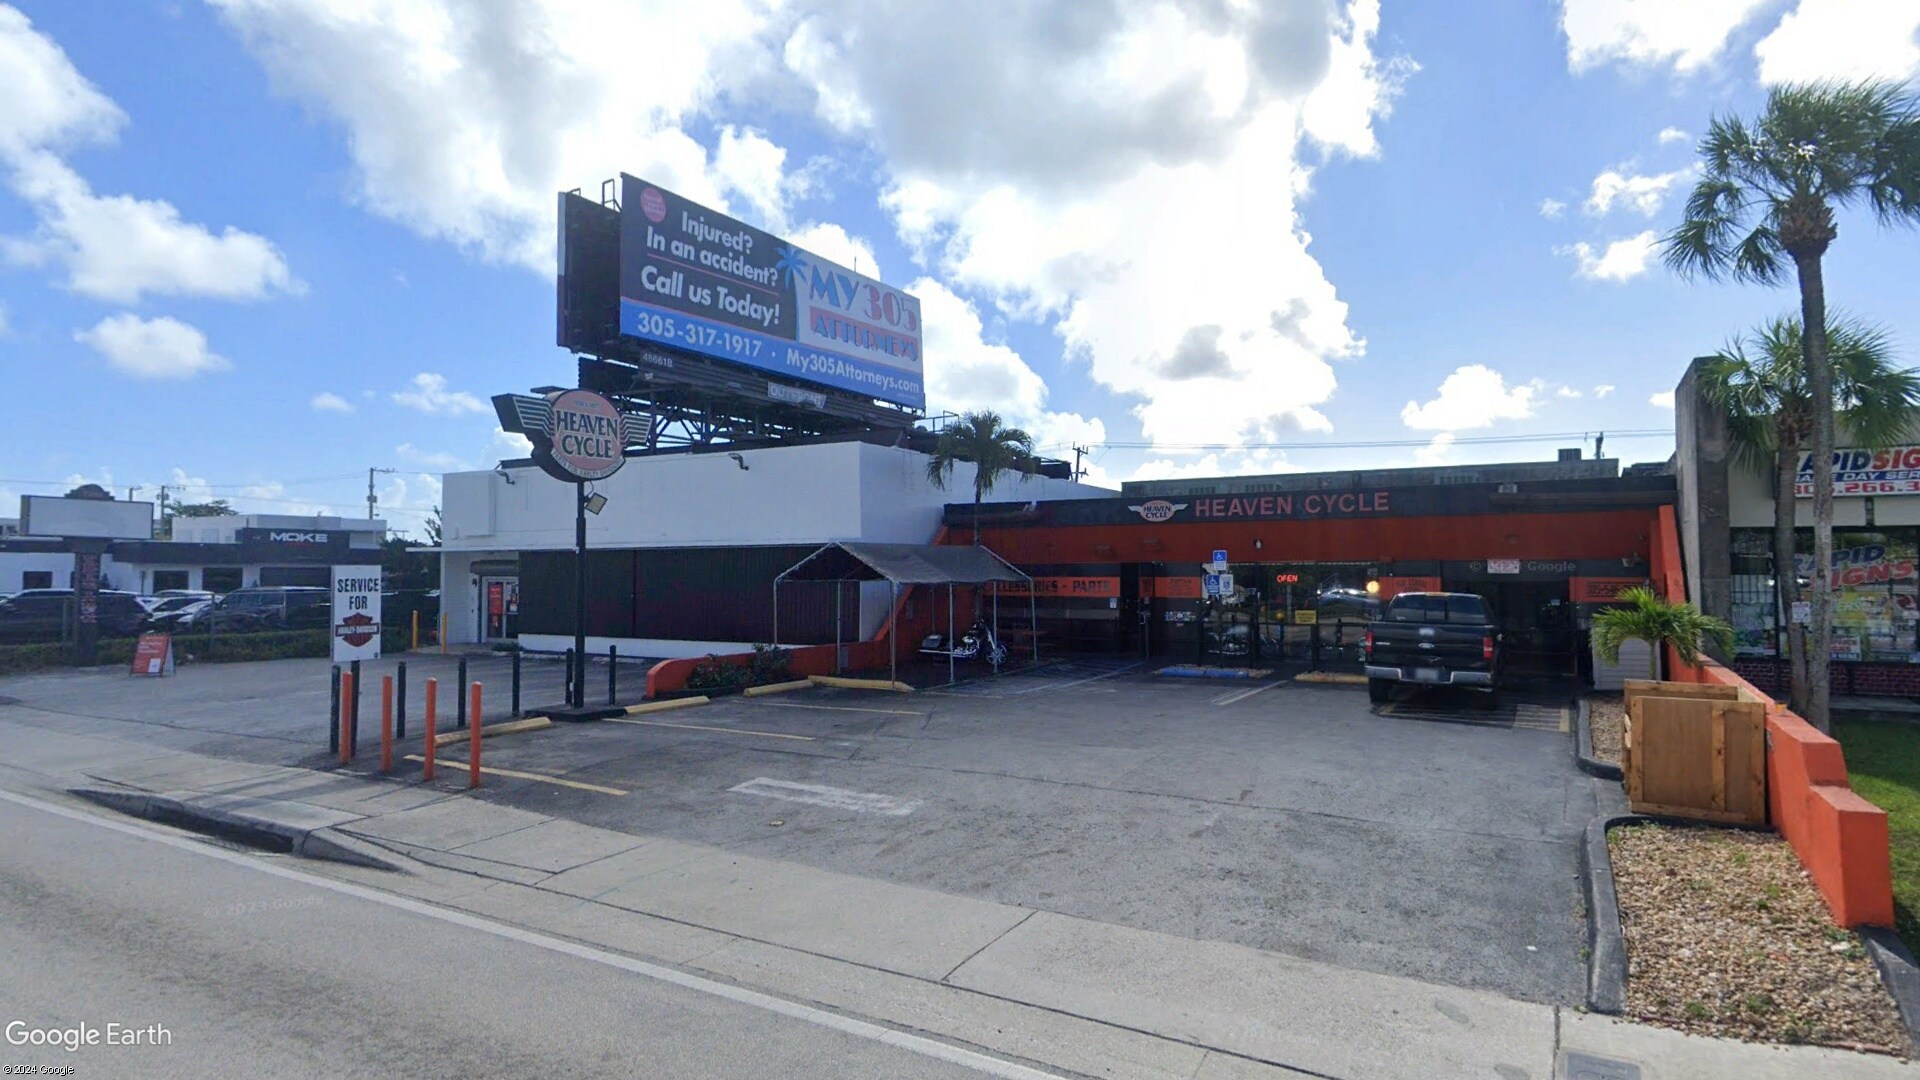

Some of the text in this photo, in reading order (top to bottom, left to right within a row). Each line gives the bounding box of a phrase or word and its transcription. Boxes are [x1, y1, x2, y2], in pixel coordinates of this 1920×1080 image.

[682, 211, 752, 253] Injured?
[646, 225, 778, 287] In an accident?
[641, 265, 780, 327] Call us Today!
[637, 312, 762, 357] 305-317-1917
[786, 348, 919, 394] My305Attorneys.com
[556, 410, 618, 441] HEAVEN
[562, 434, 612, 458] CYCLE
[1843, 472, 1880, 481] DAY
[1144, 505, 1170, 513] HEAVEN
[1195, 492, 1389, 517] HEAVEN CYCLE
[270, 532, 328, 543] MOKE
[337, 578, 379, 593] SERVICE
[1073, 580, 1110, 593] PARTS
[1276, 573, 1298, 584] OPEN
[1808, 560, 1914, 592] IGNS
[348, 595, 368, 610] FOR
